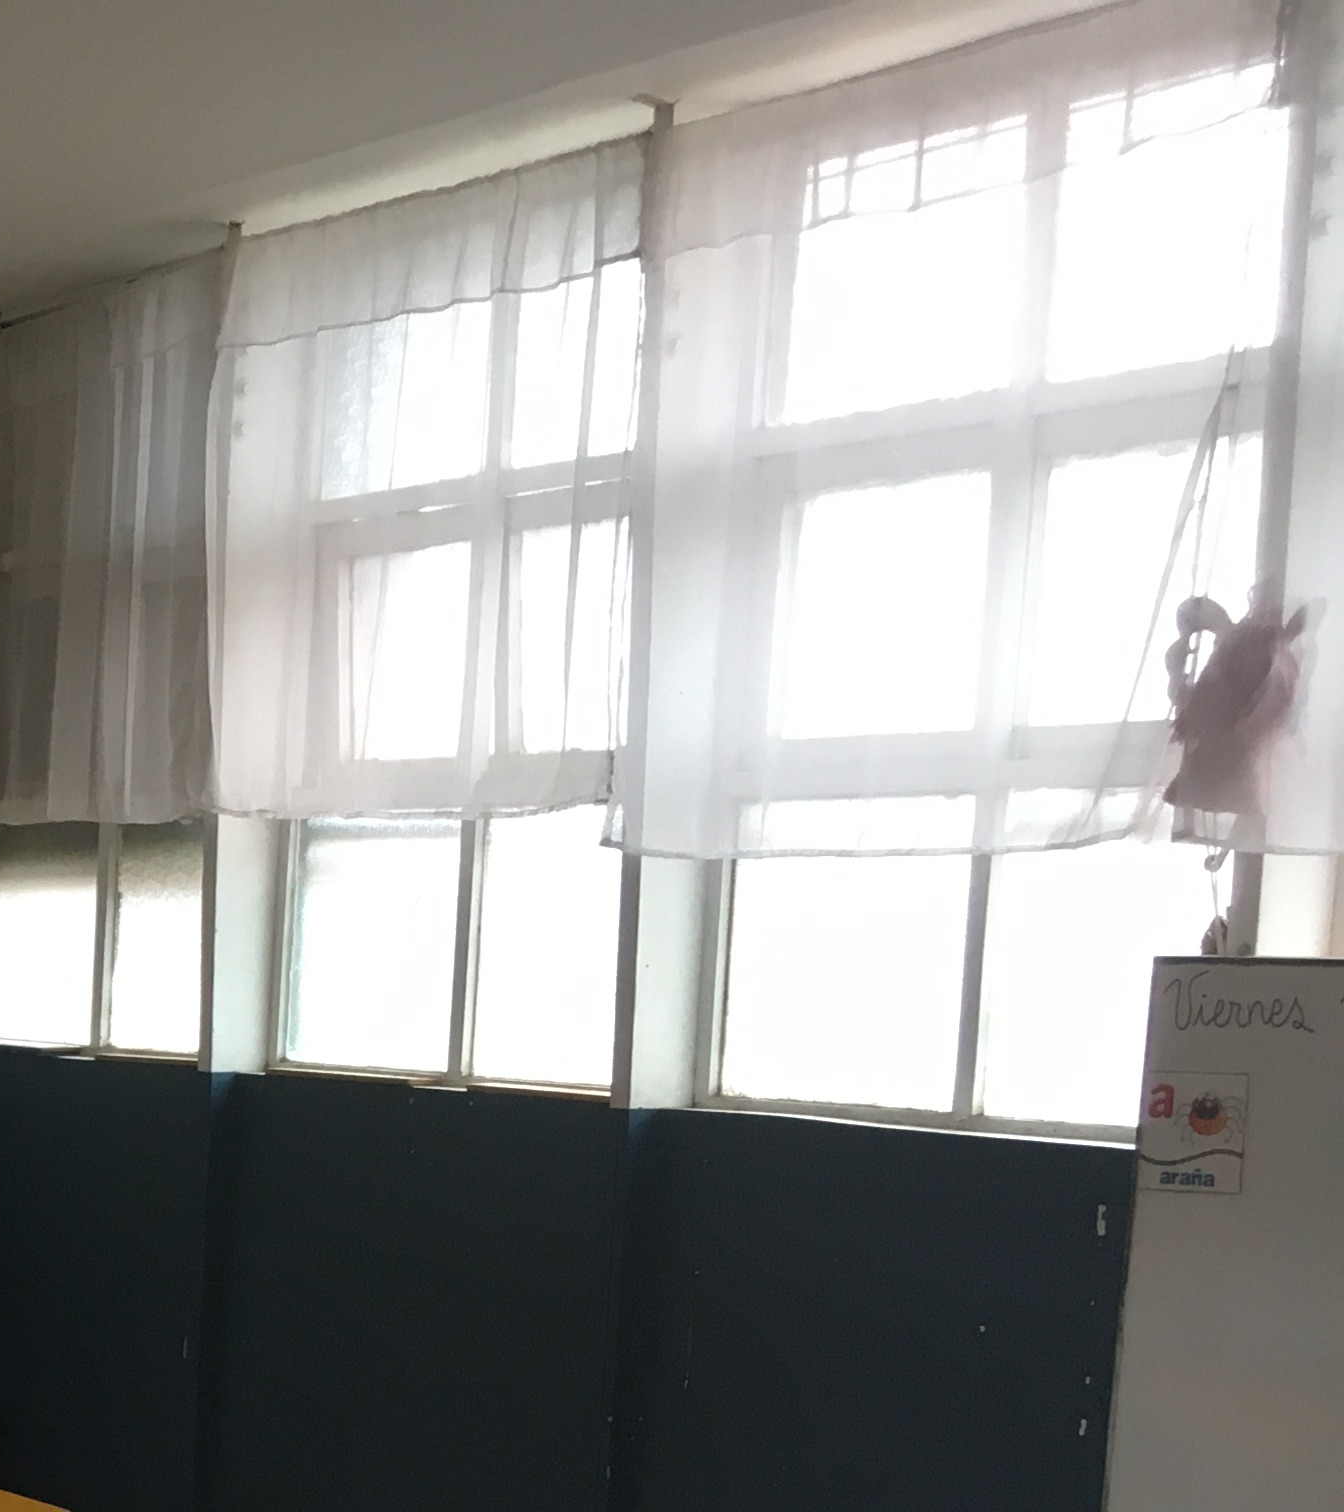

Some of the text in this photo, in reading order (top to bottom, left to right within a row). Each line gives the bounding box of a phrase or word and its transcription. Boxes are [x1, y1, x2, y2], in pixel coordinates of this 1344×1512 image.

[1164, 970, 1314, 1033] Viernes
[1147, 1083, 1175, 1119] a
[1159, 1168, 1215, 1187] araña
